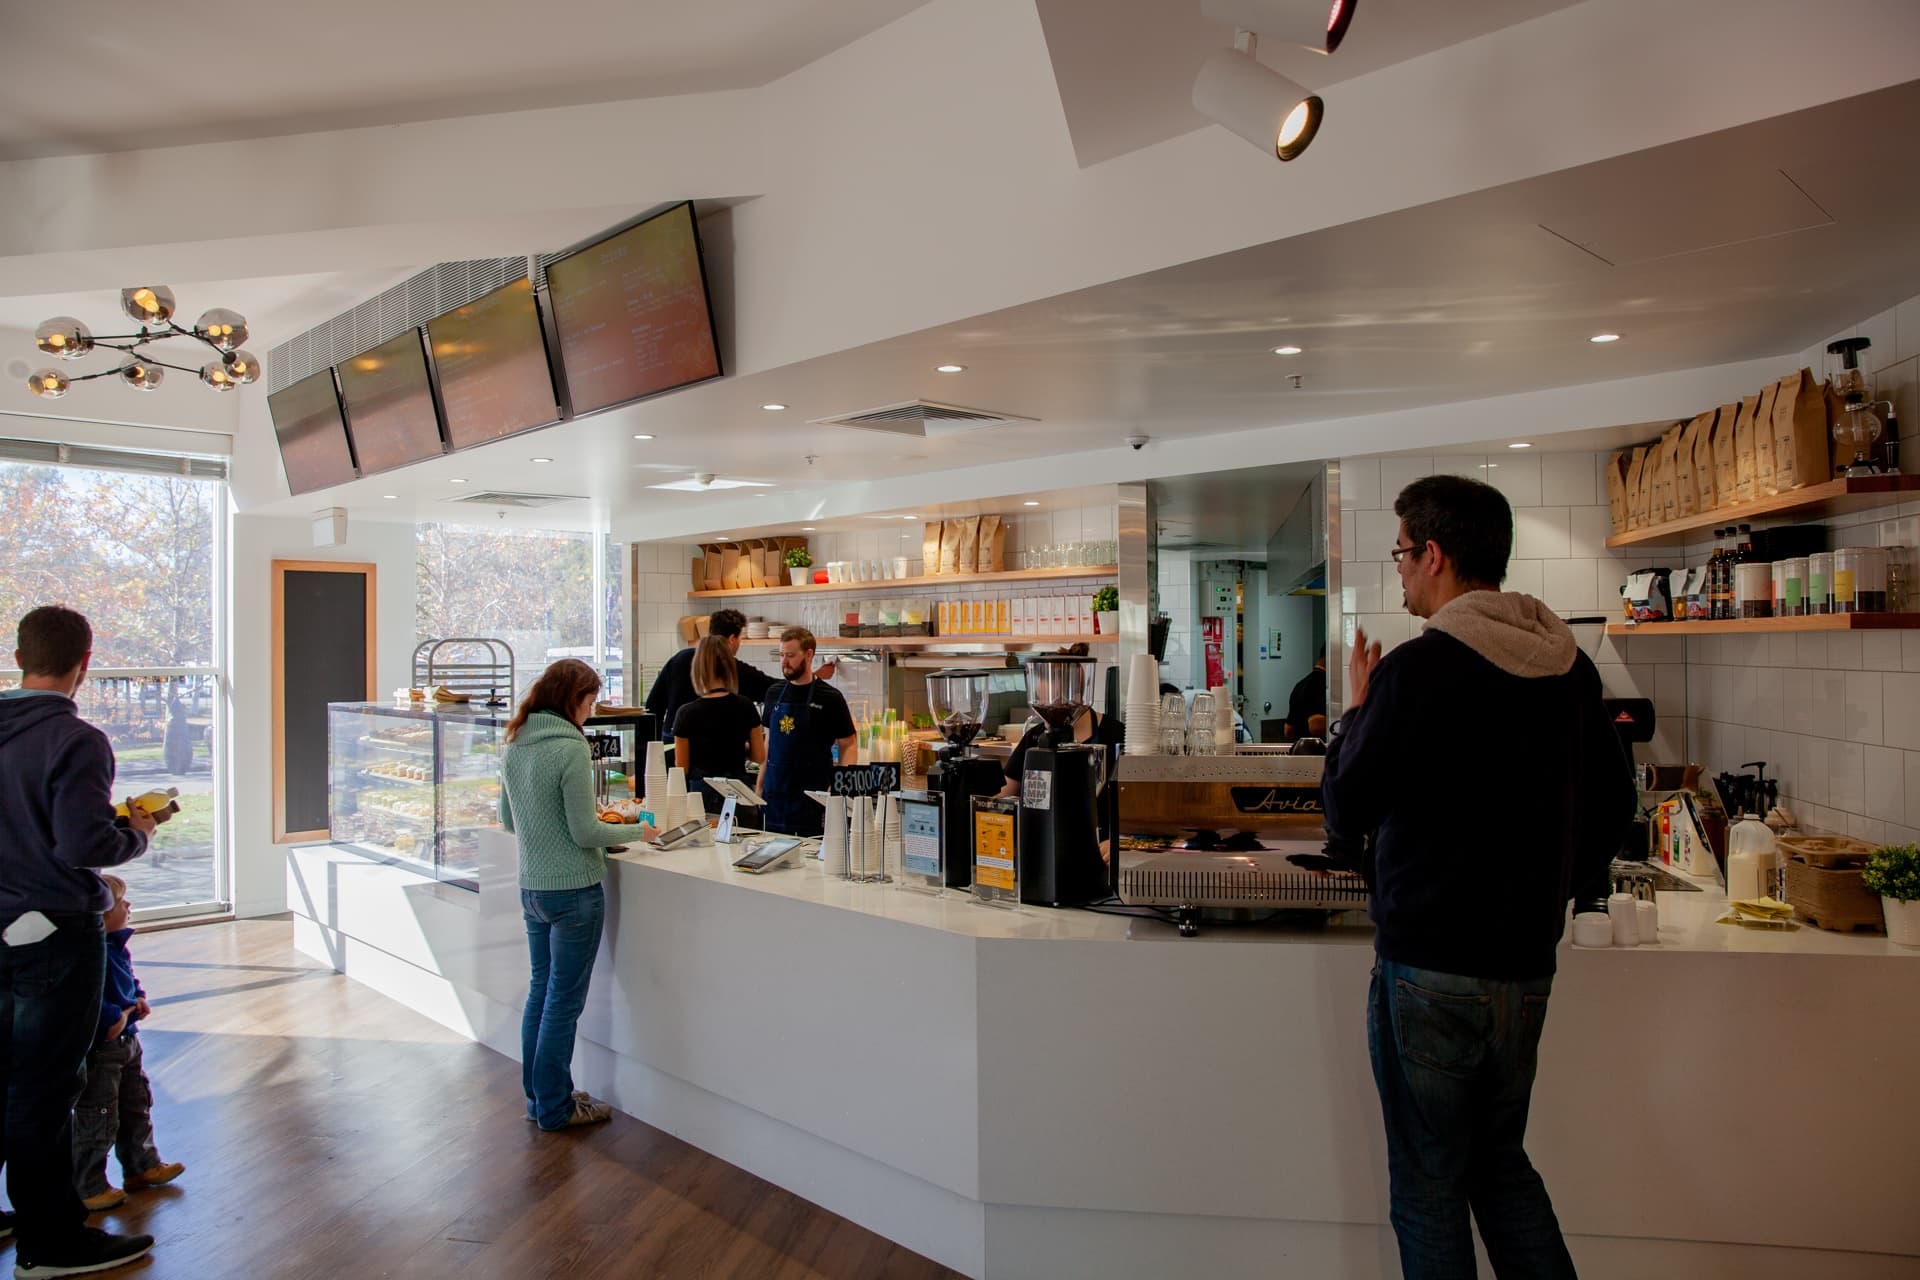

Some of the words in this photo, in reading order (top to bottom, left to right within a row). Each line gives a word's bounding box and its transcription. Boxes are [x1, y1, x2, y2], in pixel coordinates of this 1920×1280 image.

[603, 739, 618, 753] 74
[836, 771, 853, 792] 83
[1243, 788, 1323, 811] Avia
